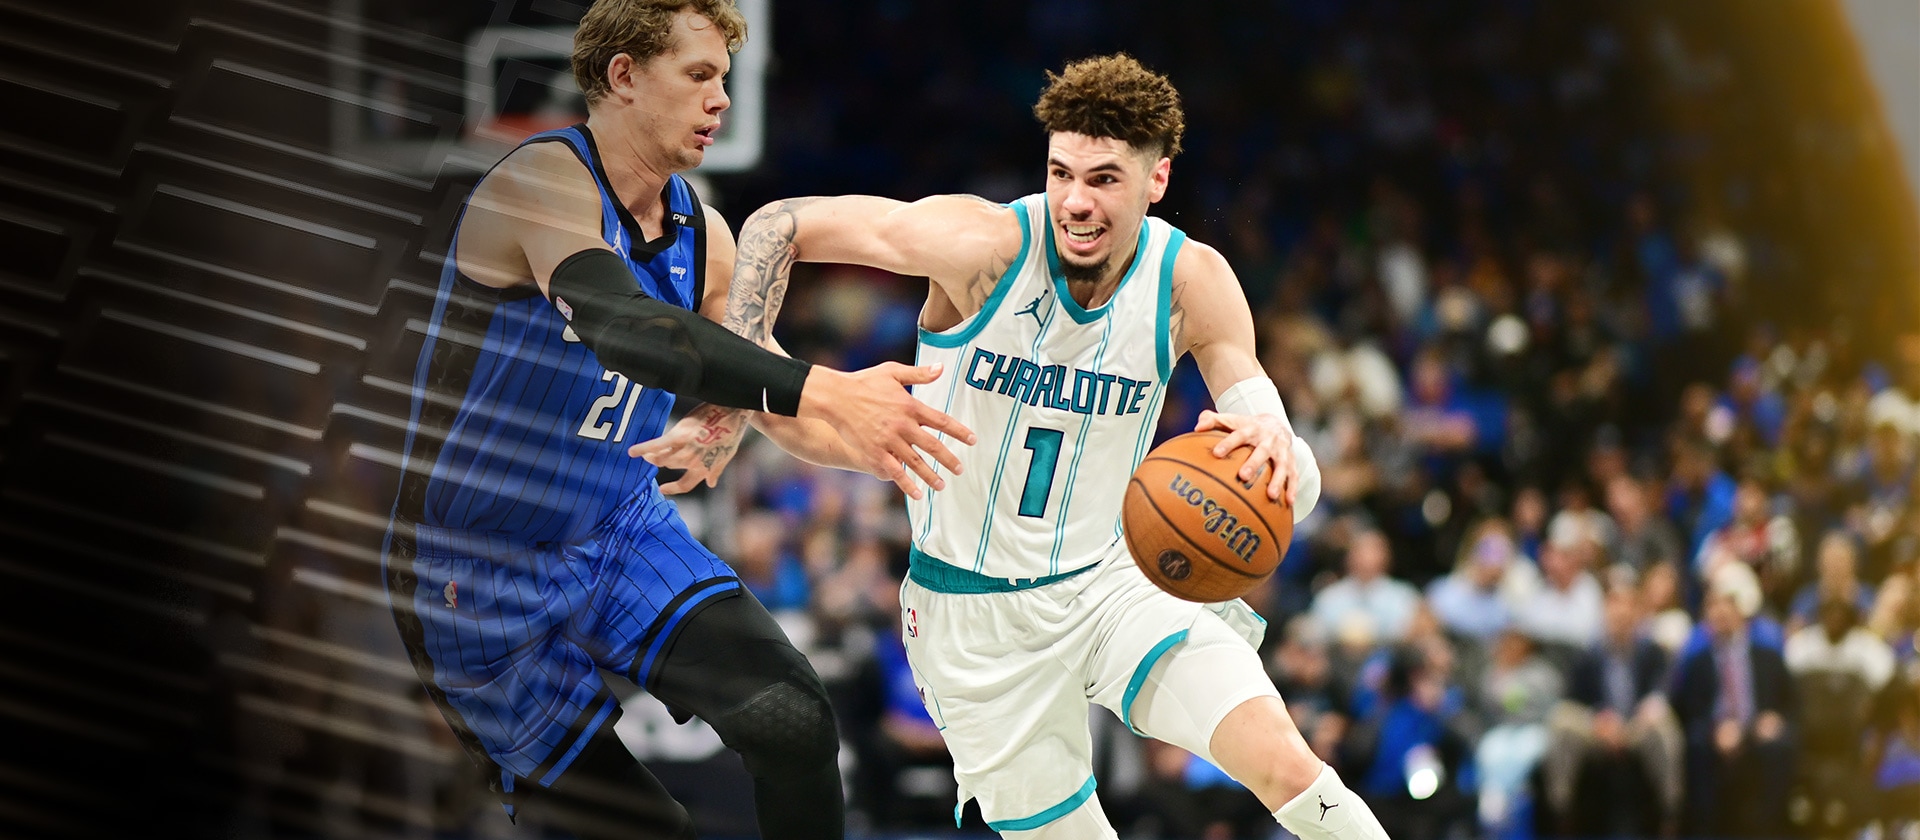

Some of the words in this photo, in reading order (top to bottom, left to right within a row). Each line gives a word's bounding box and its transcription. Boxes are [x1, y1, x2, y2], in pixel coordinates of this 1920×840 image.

[672, 213, 687, 225] PW
[576, 368, 644, 443] 21
[965, 346, 1152, 416] CHARLOTTE
[1017, 426, 1065, 519] 1
[1168, 473, 1262, 564] Wilson
